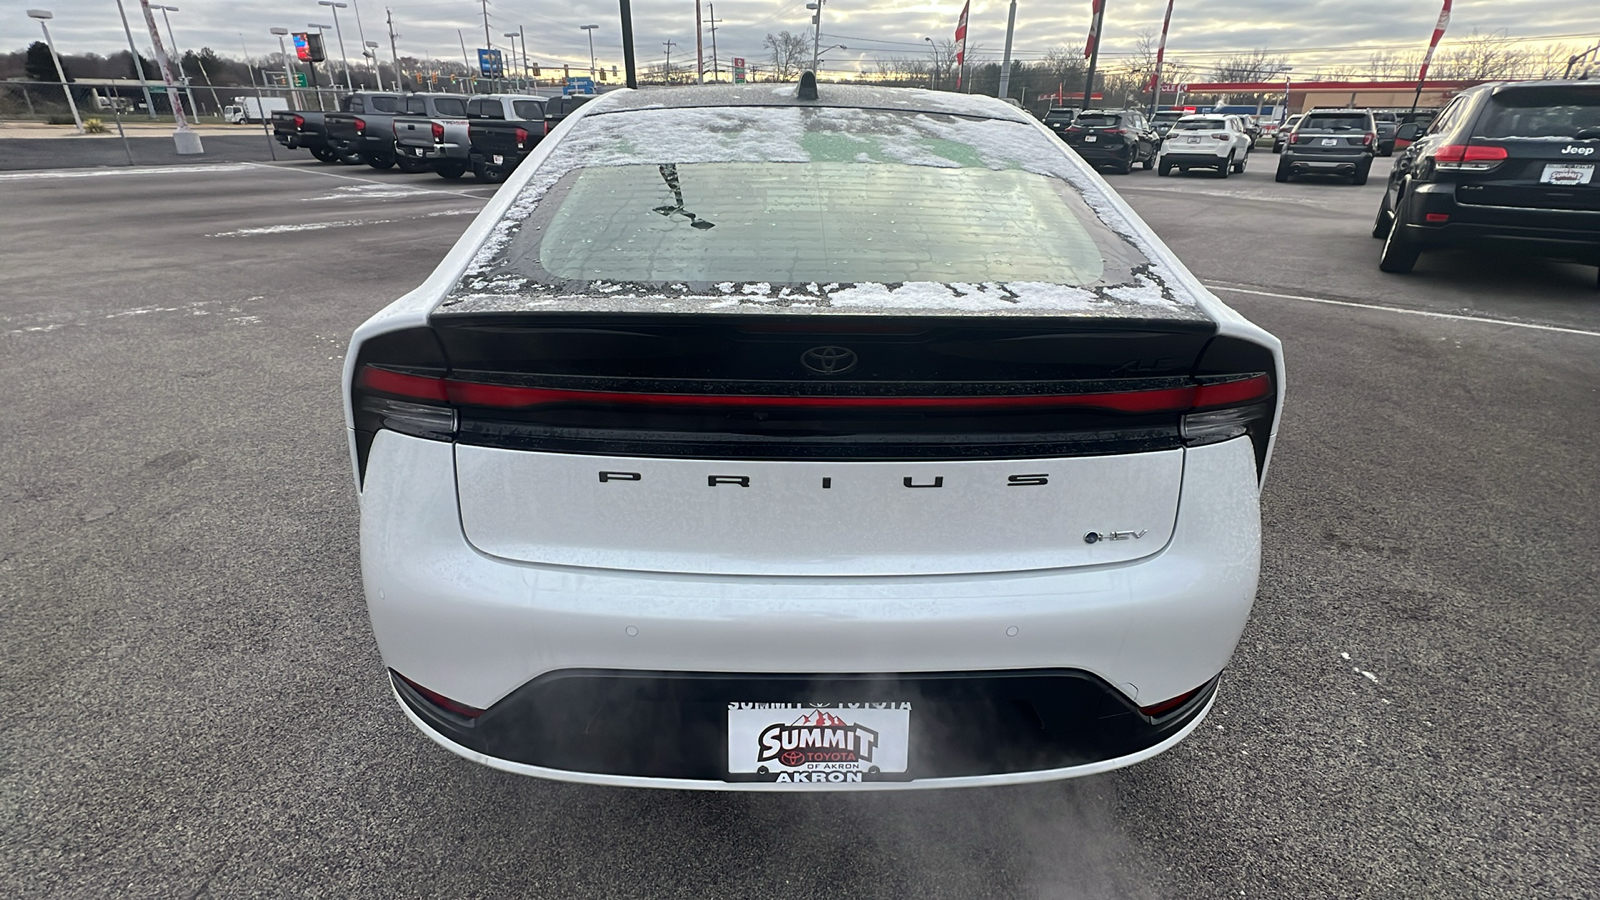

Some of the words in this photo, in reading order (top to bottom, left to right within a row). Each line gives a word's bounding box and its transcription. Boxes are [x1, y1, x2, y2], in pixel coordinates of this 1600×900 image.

[1148, 84, 1176, 92] CCLE
[1561, 145, 1594, 156] Jeep
[1551, 172, 1583, 180] SUMMIT
[599, 471, 1049, 489] PRIUS
[1098, 529, 1148, 541] HEV
[762, 727, 874, 758] SUMMIT
[807, 752, 856, 761] TOYOTA
[776, 772, 863, 783] AKRON
